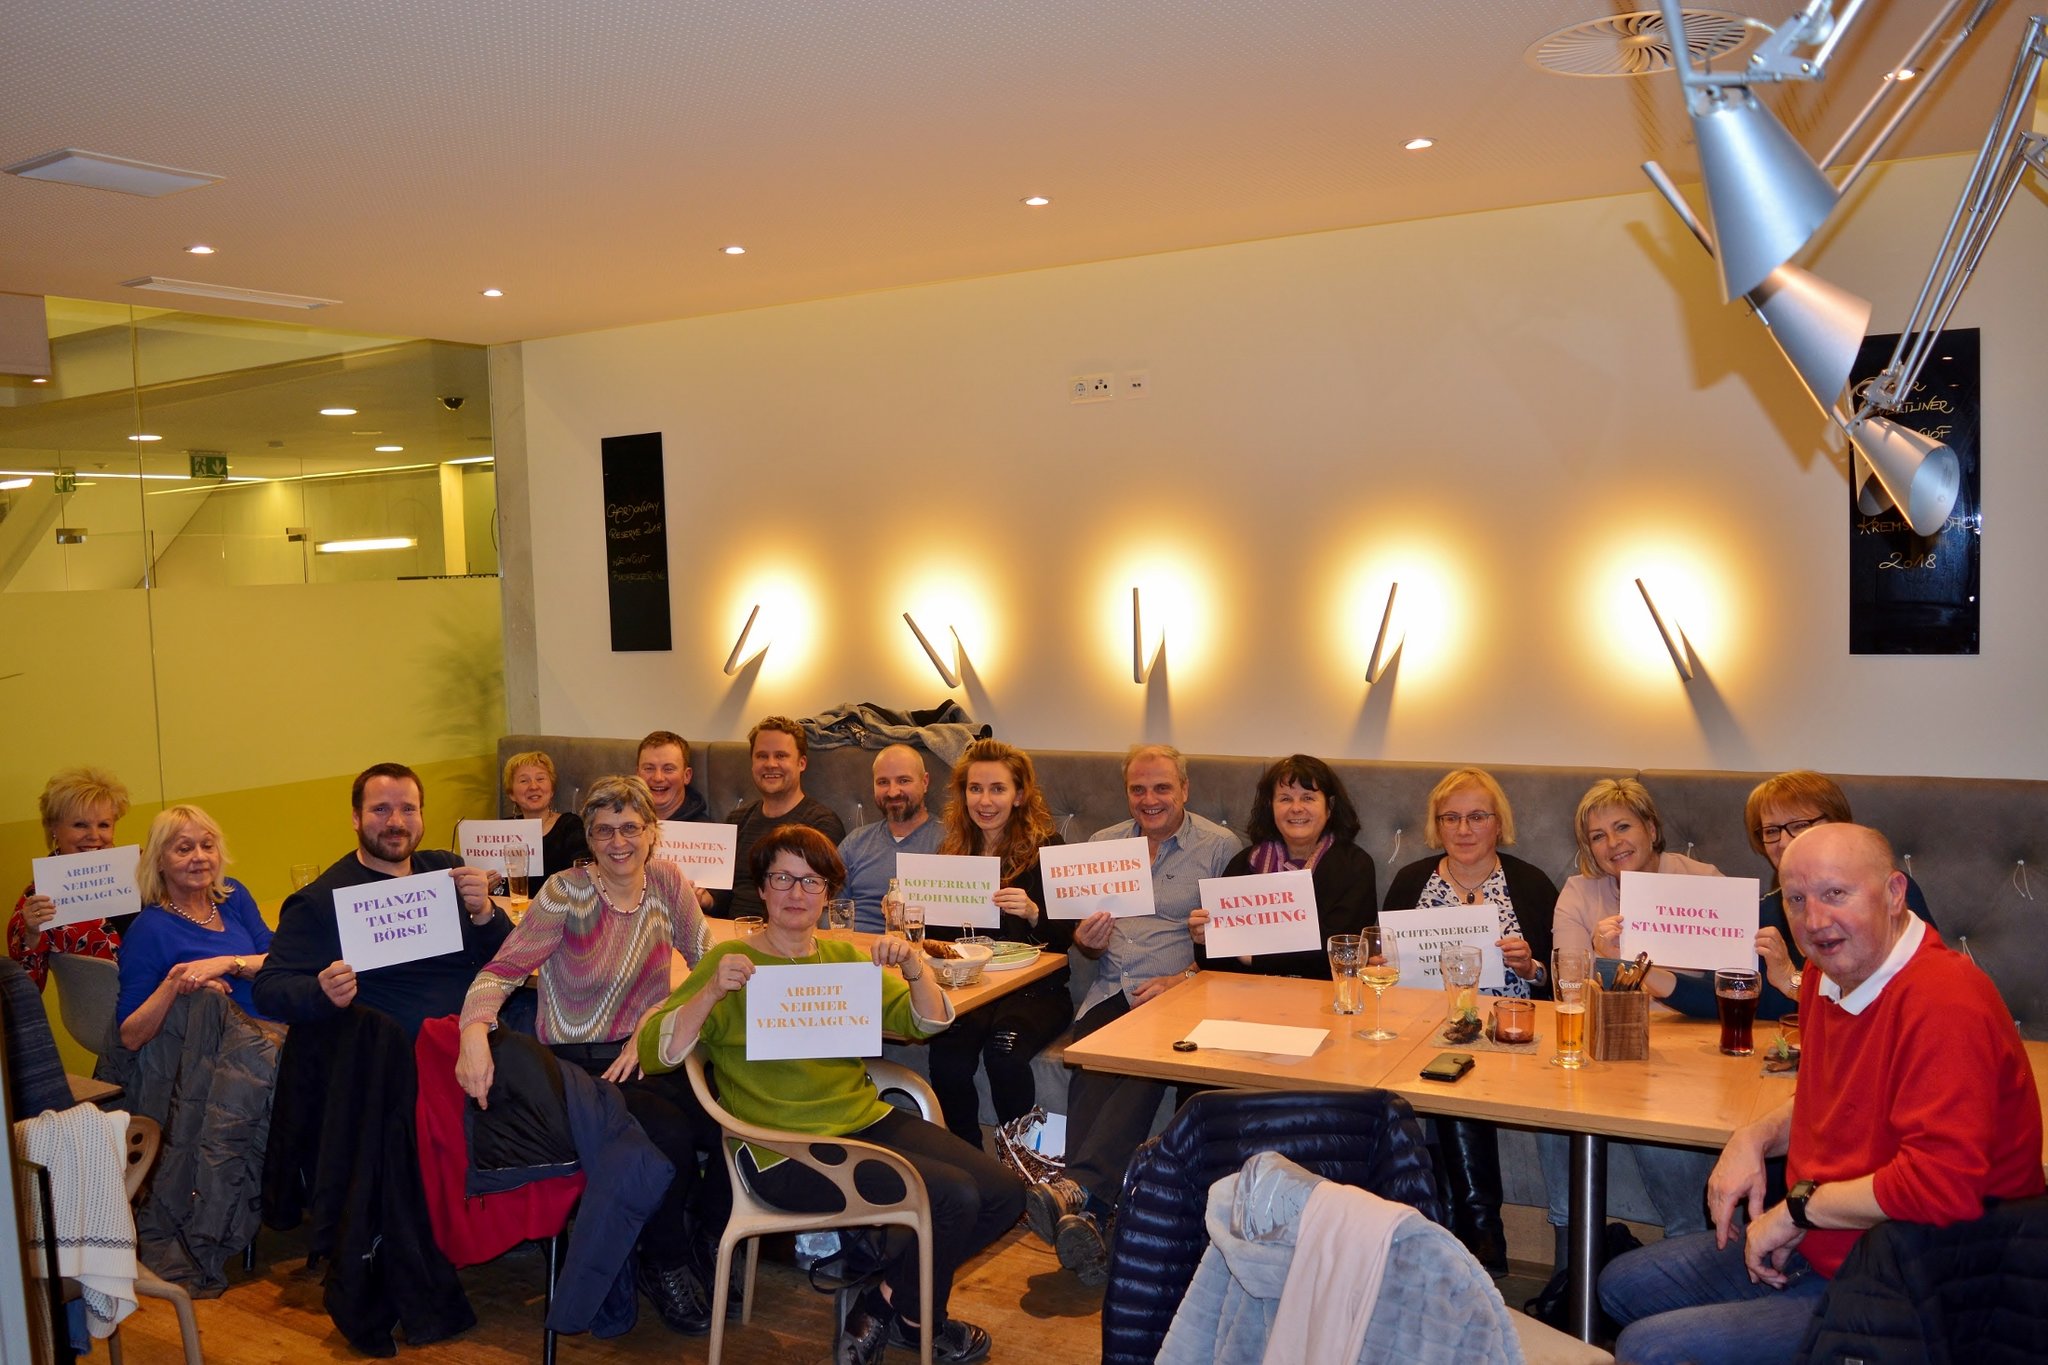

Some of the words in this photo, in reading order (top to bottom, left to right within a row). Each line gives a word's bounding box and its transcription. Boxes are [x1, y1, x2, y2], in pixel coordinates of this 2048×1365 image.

[1857, 516, 1912, 535] KREMS
[1879, 552, 1937, 569] 2018
[477, 834, 522, 843] FERIEN
[657, 840, 727, 851] ANDKISTEN-
[65, 863, 111, 878] ARBEIT
[1050, 858, 1142, 878] BETRIEBS
[63, 876, 115, 892] NEHMER
[904, 878, 991, 890] KOFFERRAUM
[1055, 879, 1140, 898] BESUCHE
[53, 886, 132, 907] ERANLAGUNG
[353, 888, 437, 913] PFLANZEN
[908, 892, 988, 904] FLOHMARKT
[1219, 891, 1295, 909] KINDER
[365, 906, 428, 928] TAUSCH
[1213, 908, 1306, 929] FASCHING
[1655, 905, 1719, 919] TAROCK
[373, 923, 428, 943] BÖRSE
[1386, 925, 1489, 941] LICHTENBERGER
[1631, 921, 1745, 938] STAMMTISCHE
[1418, 940, 1463, 951] ADVENT
[785, 985, 843, 998] ARBEIT
[780, 1000, 848, 1013] NEHMER
[756, 1015, 870, 1029] VERANLAGUNG
